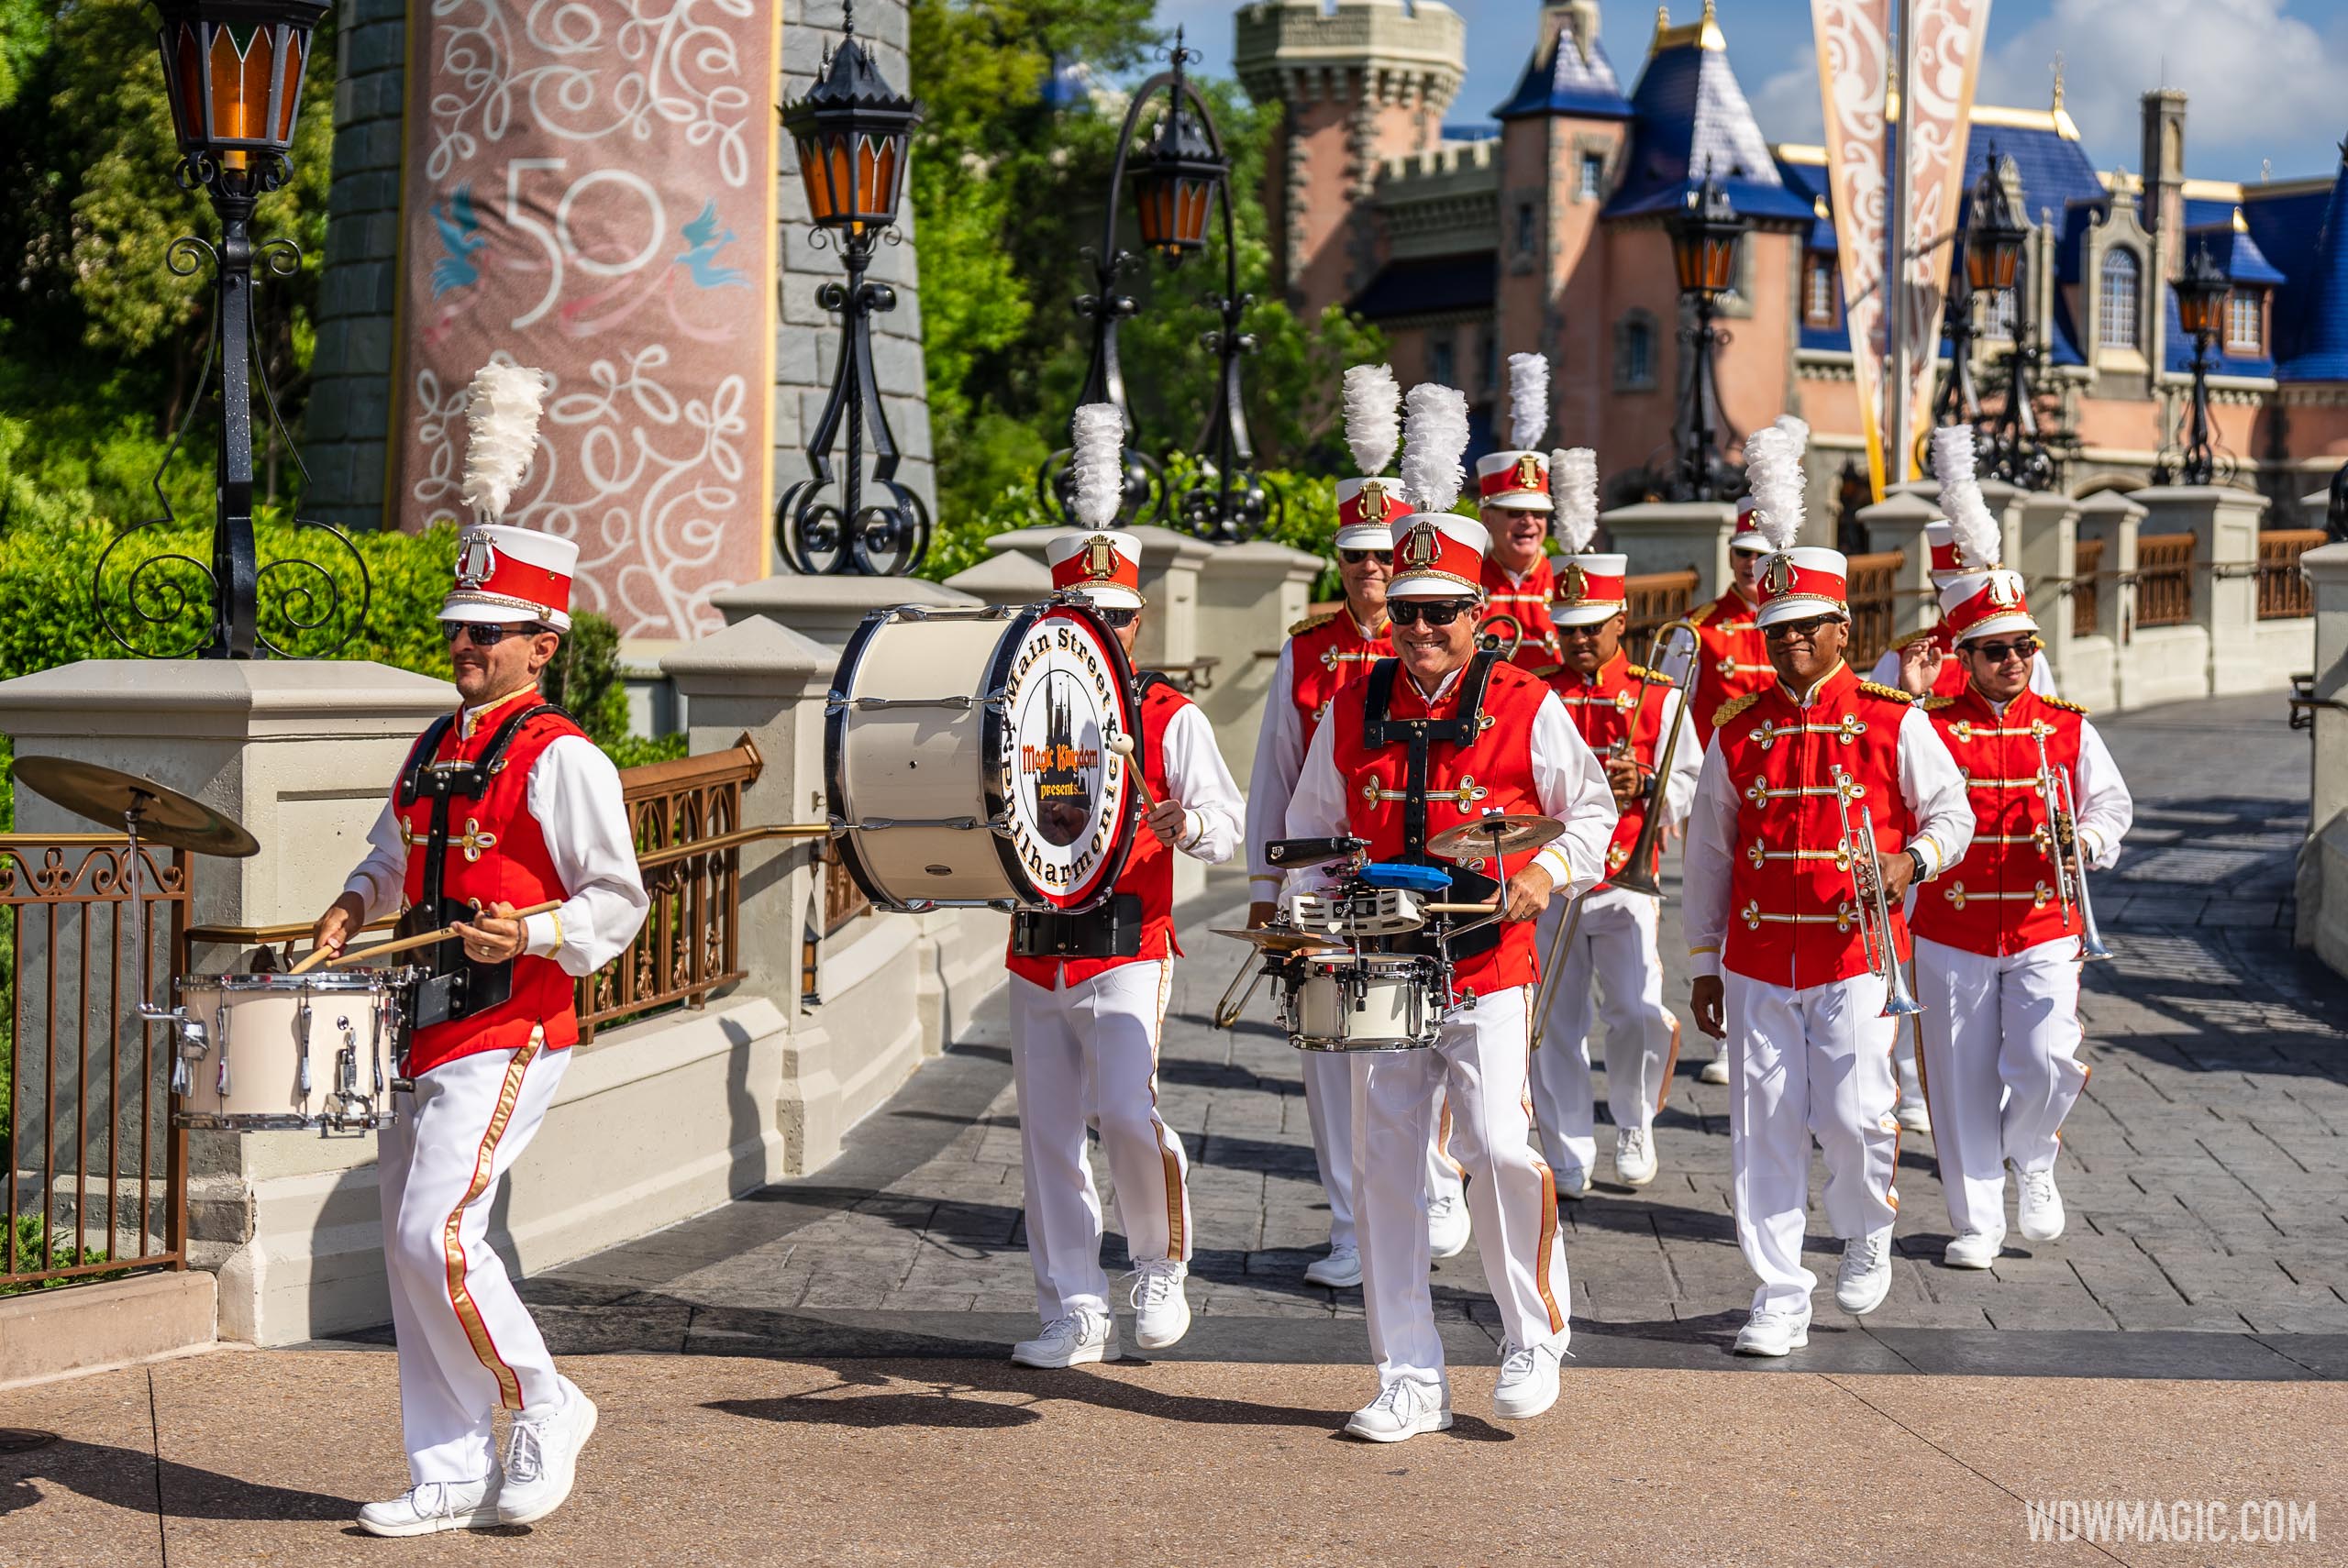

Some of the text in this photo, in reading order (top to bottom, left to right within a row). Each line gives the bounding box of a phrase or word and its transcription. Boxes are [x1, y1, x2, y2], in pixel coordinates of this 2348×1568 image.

[506, 157, 666, 331] 50
[1006, 627, 1111, 712] Main Street
[1023, 743, 1099, 775] Magic Kingdom
[1040, 781, 1086, 800] presents...
[999, 756, 1119, 887] Philharmonic
